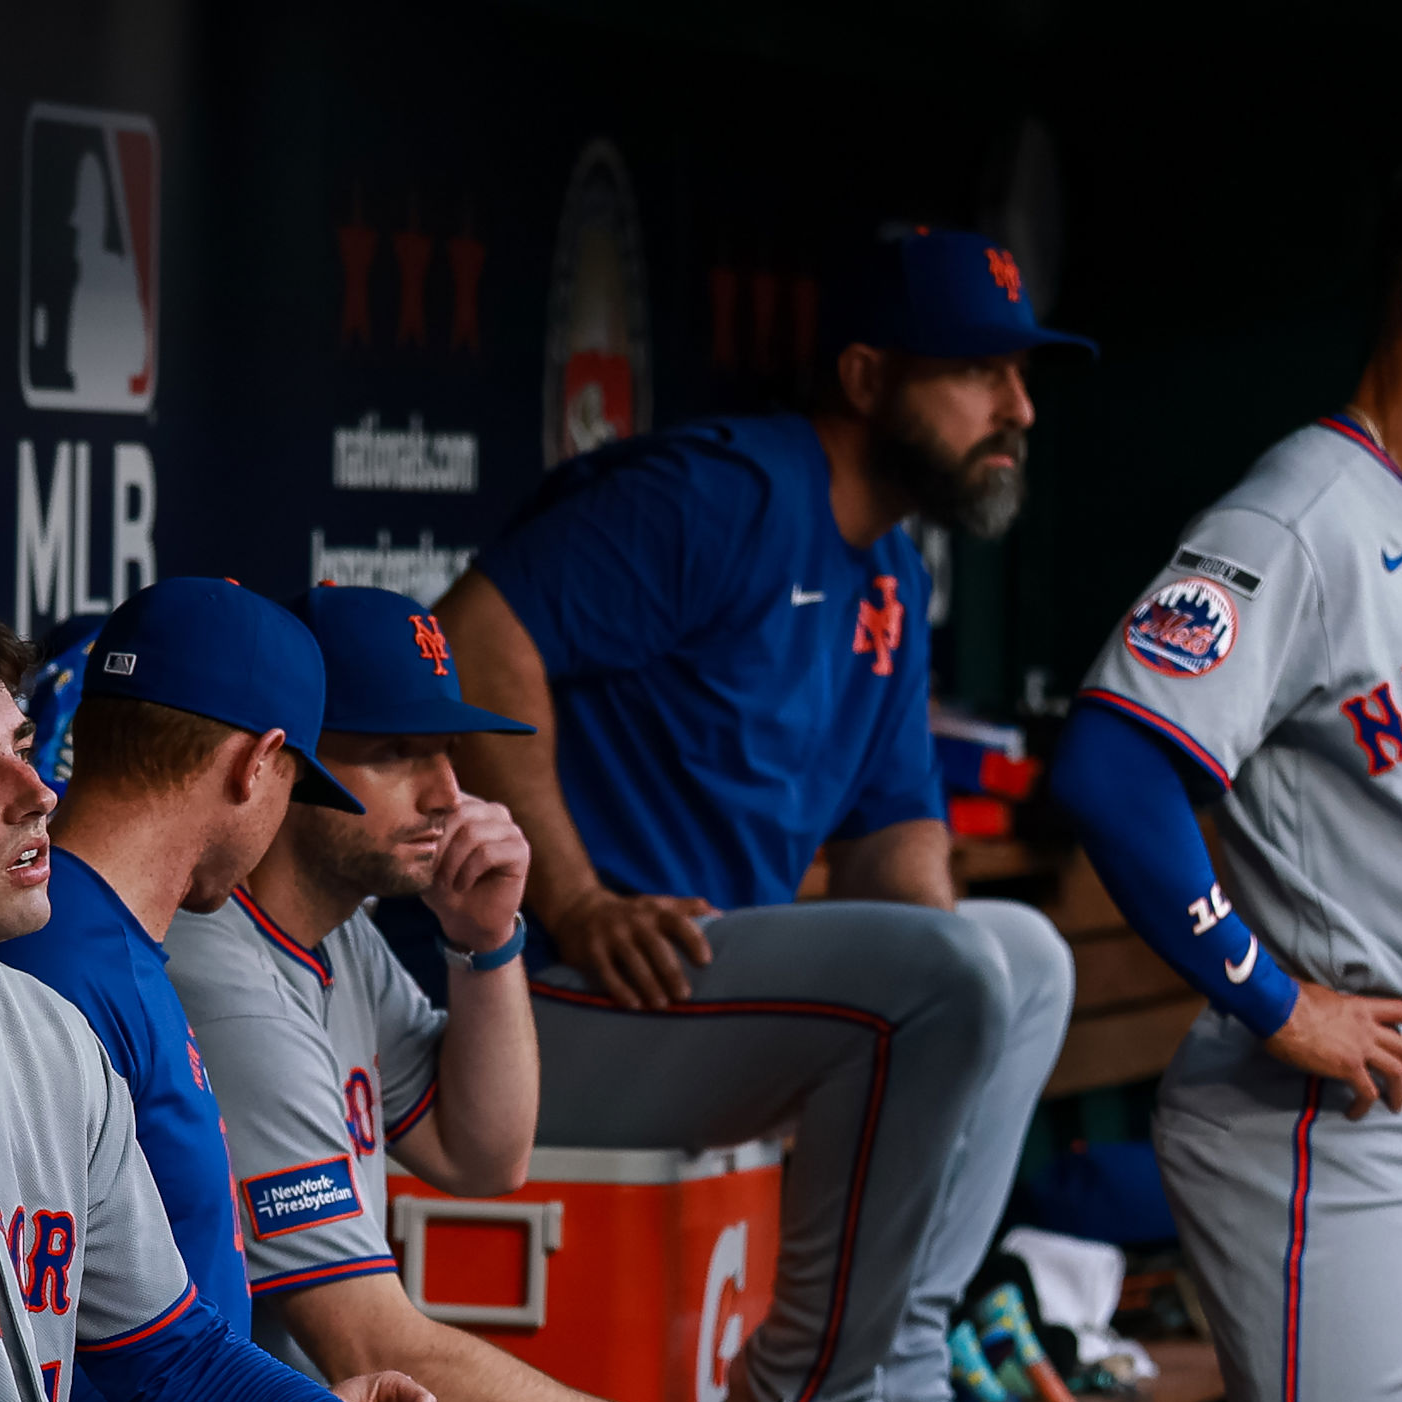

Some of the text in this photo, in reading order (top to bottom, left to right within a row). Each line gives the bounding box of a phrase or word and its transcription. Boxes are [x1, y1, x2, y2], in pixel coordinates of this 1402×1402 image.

[15, 438, 158, 643] MLB
[1139, 608, 1217, 657] Mets
[270, 1174, 335, 1202] NewYork-
[274, 1186, 353, 1217] Presbyterian
